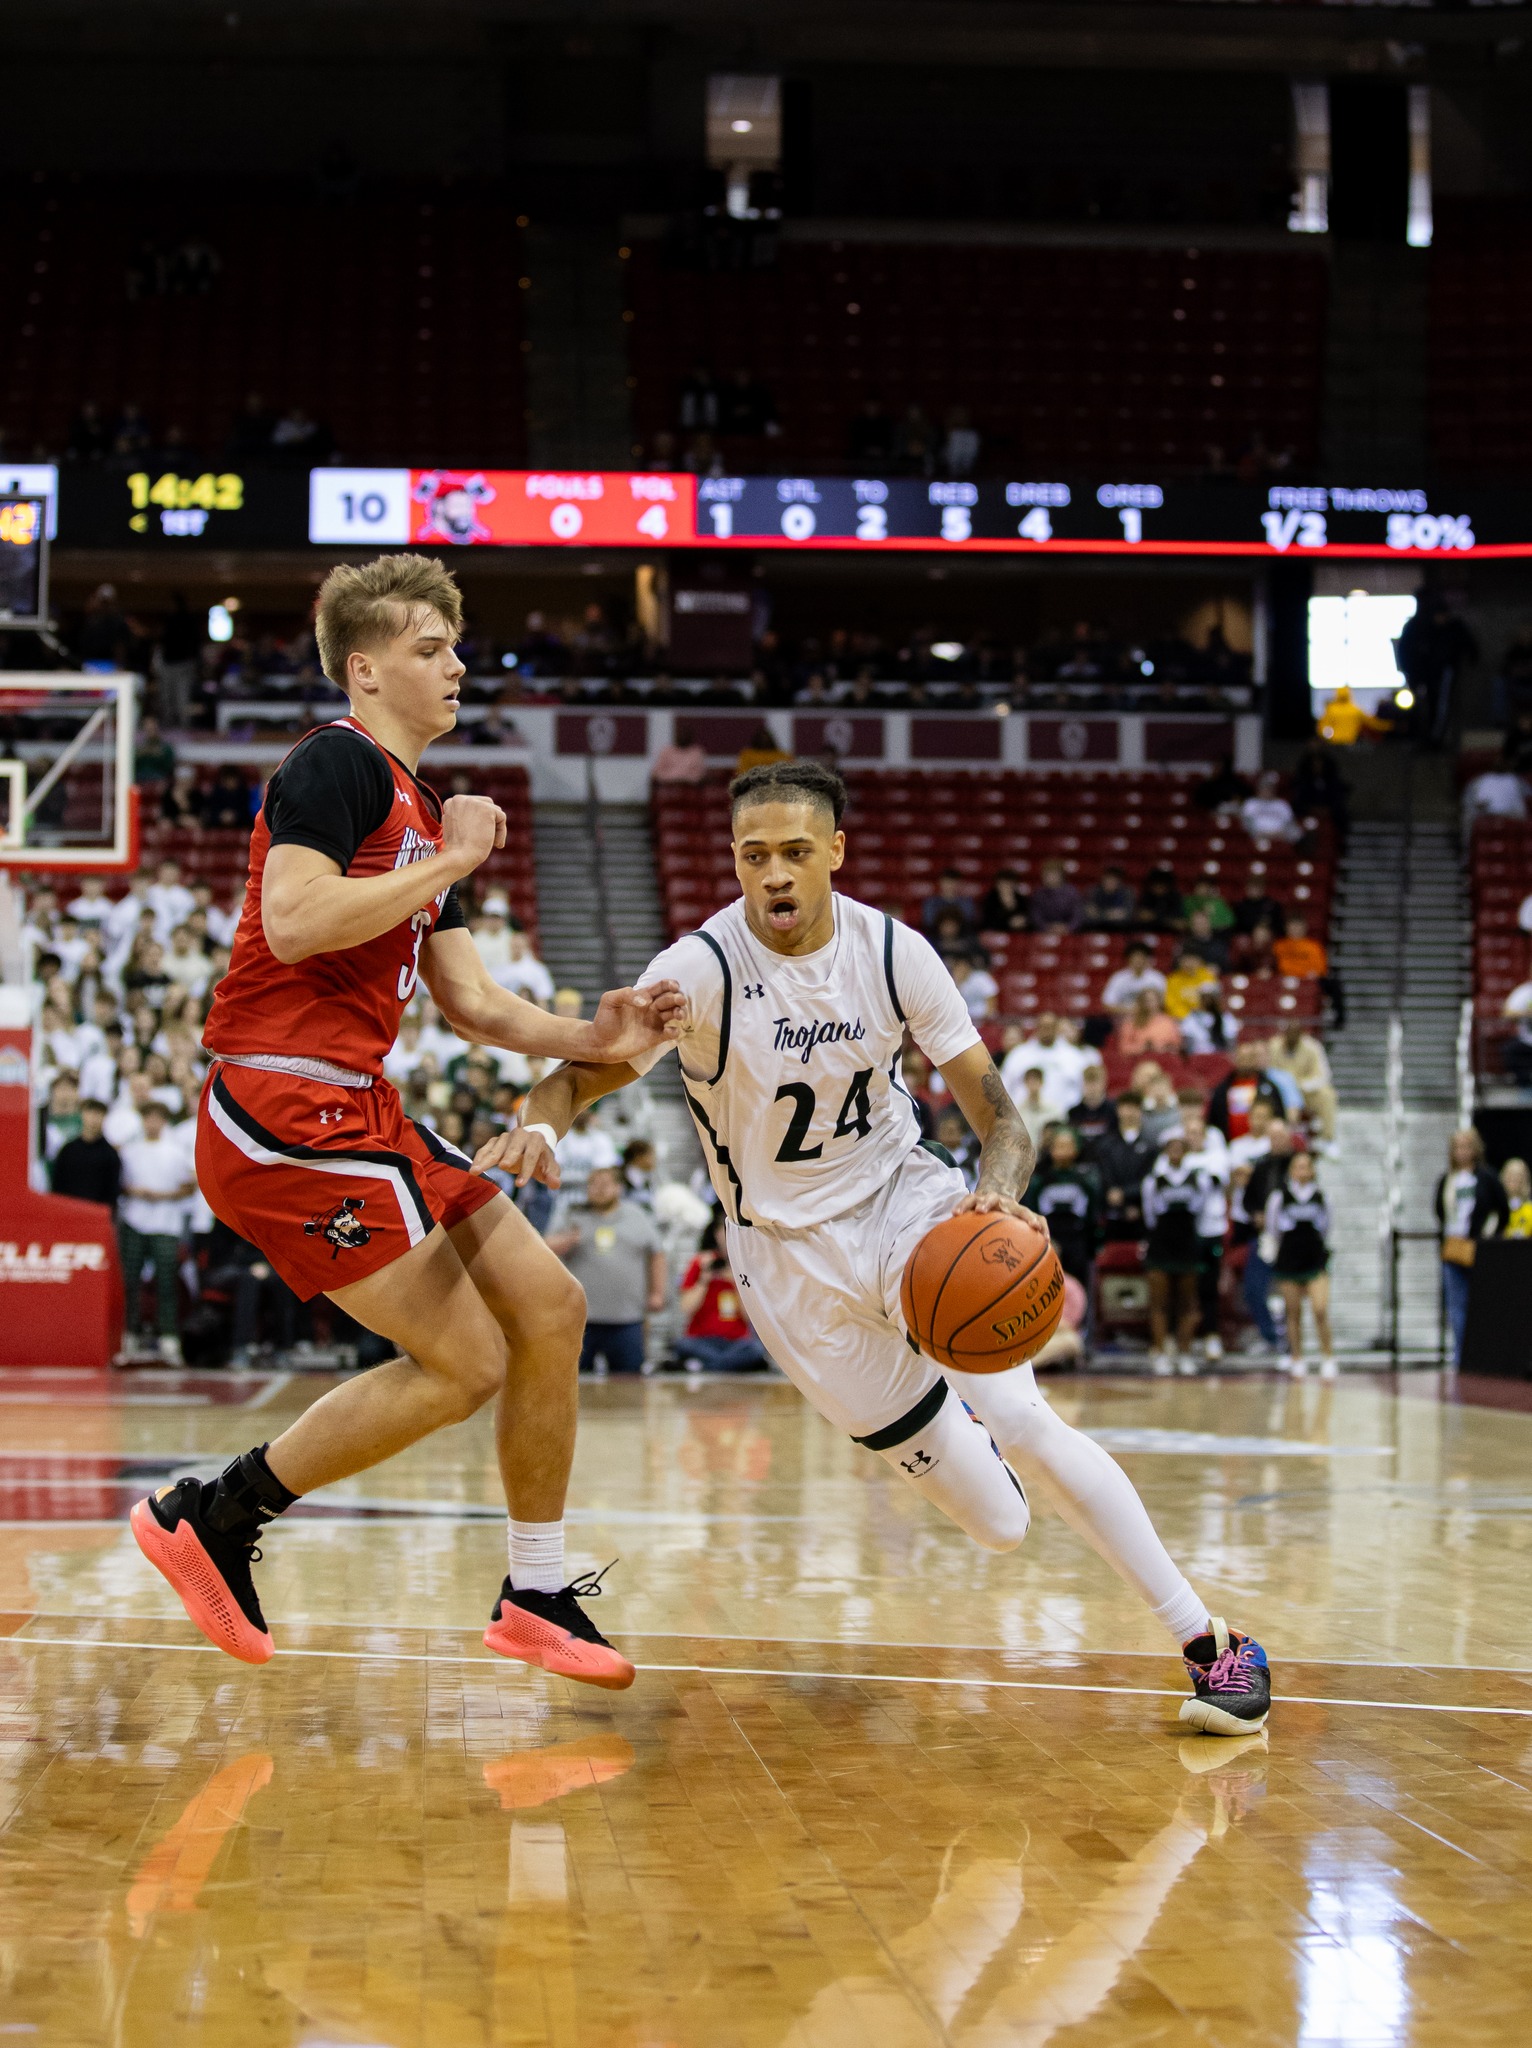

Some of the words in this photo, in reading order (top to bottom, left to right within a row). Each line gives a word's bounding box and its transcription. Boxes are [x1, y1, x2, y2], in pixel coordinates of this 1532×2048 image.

[127, 472, 244, 510] 14:42
[341, 493, 387, 523] 10
[852, 480, 888, 504] TO
[1269, 486, 1329, 511] FREE
[1330, 487, 1428, 513] THROWS
[550, 503, 583, 539] 0
[637, 504, 669, 540] 4
[709, 503, 733, 539] 1
[780, 504, 816, 541] 0
[856, 504, 888, 541] 2
[940, 506, 973, 542] 5
[1017, 507, 1053, 543] 4
[1118, 508, 1143, 544] 1
[1260, 508, 1328, 552] 1/2
[1385, 513, 1476, 551] 50%
[773, 1016, 866, 1064] Trojans
[773, 1066, 874, 1163] 24
[0, 1241, 109, 1271] LLER
[991, 1262, 1065, 1345] SPALDING
